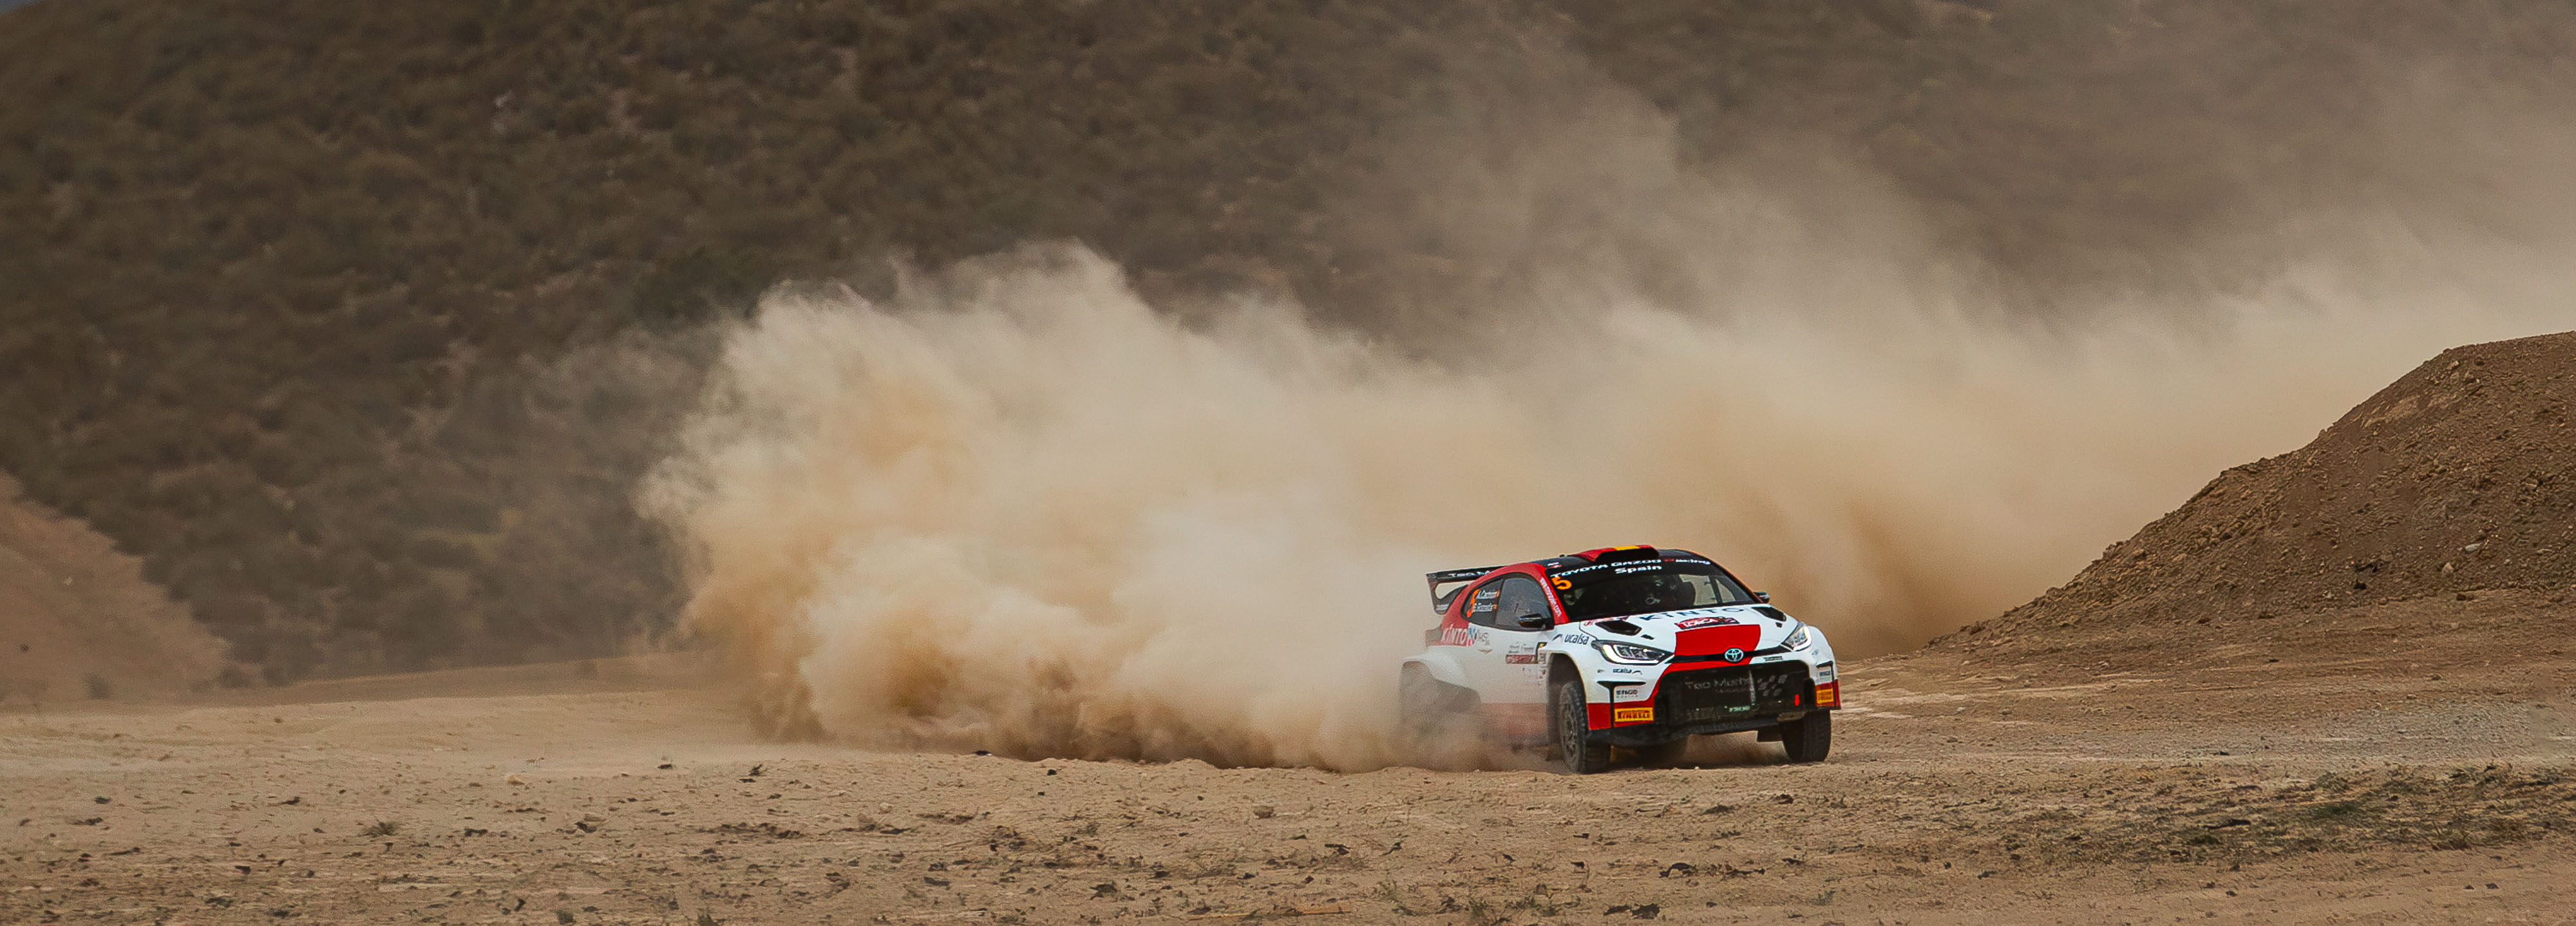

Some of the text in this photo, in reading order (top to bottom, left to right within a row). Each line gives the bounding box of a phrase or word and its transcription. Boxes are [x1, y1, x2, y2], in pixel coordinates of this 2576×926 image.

[1550, 564, 1608, 578] TOYOTA
[1615, 565, 1662, 574] Spain
[1551, 577, 1571, 590] 5
[1564, 634, 1589, 645] ucalsa
[1617, 710, 1650, 719] PIRELLI
